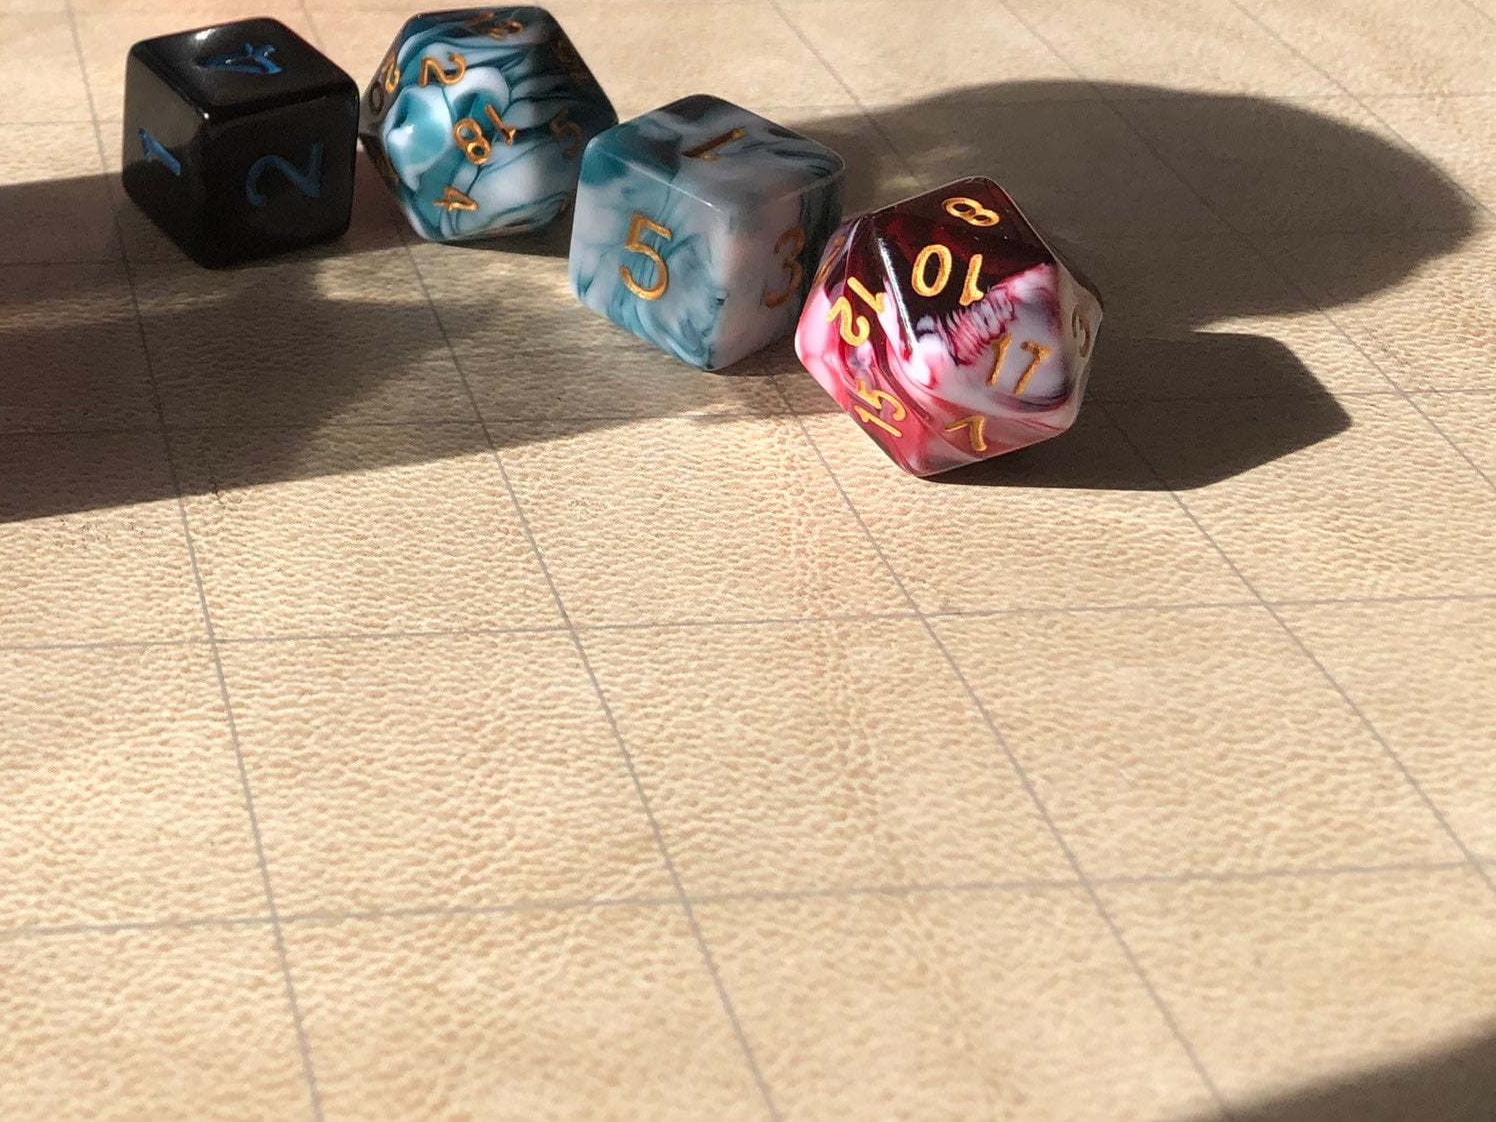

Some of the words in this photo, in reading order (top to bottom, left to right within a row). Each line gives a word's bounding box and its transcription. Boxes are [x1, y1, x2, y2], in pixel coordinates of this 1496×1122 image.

[416, 52, 468, 88] 2
[245, 142, 325, 208] 2
[940, 196, 1001, 227] 8
[617, 211, 675, 302] 5
[763, 225, 806, 309] 3
[910, 243, 985, 307] 10
[824, 276, 885, 348] 12
[853, 379, 907, 439] 15
